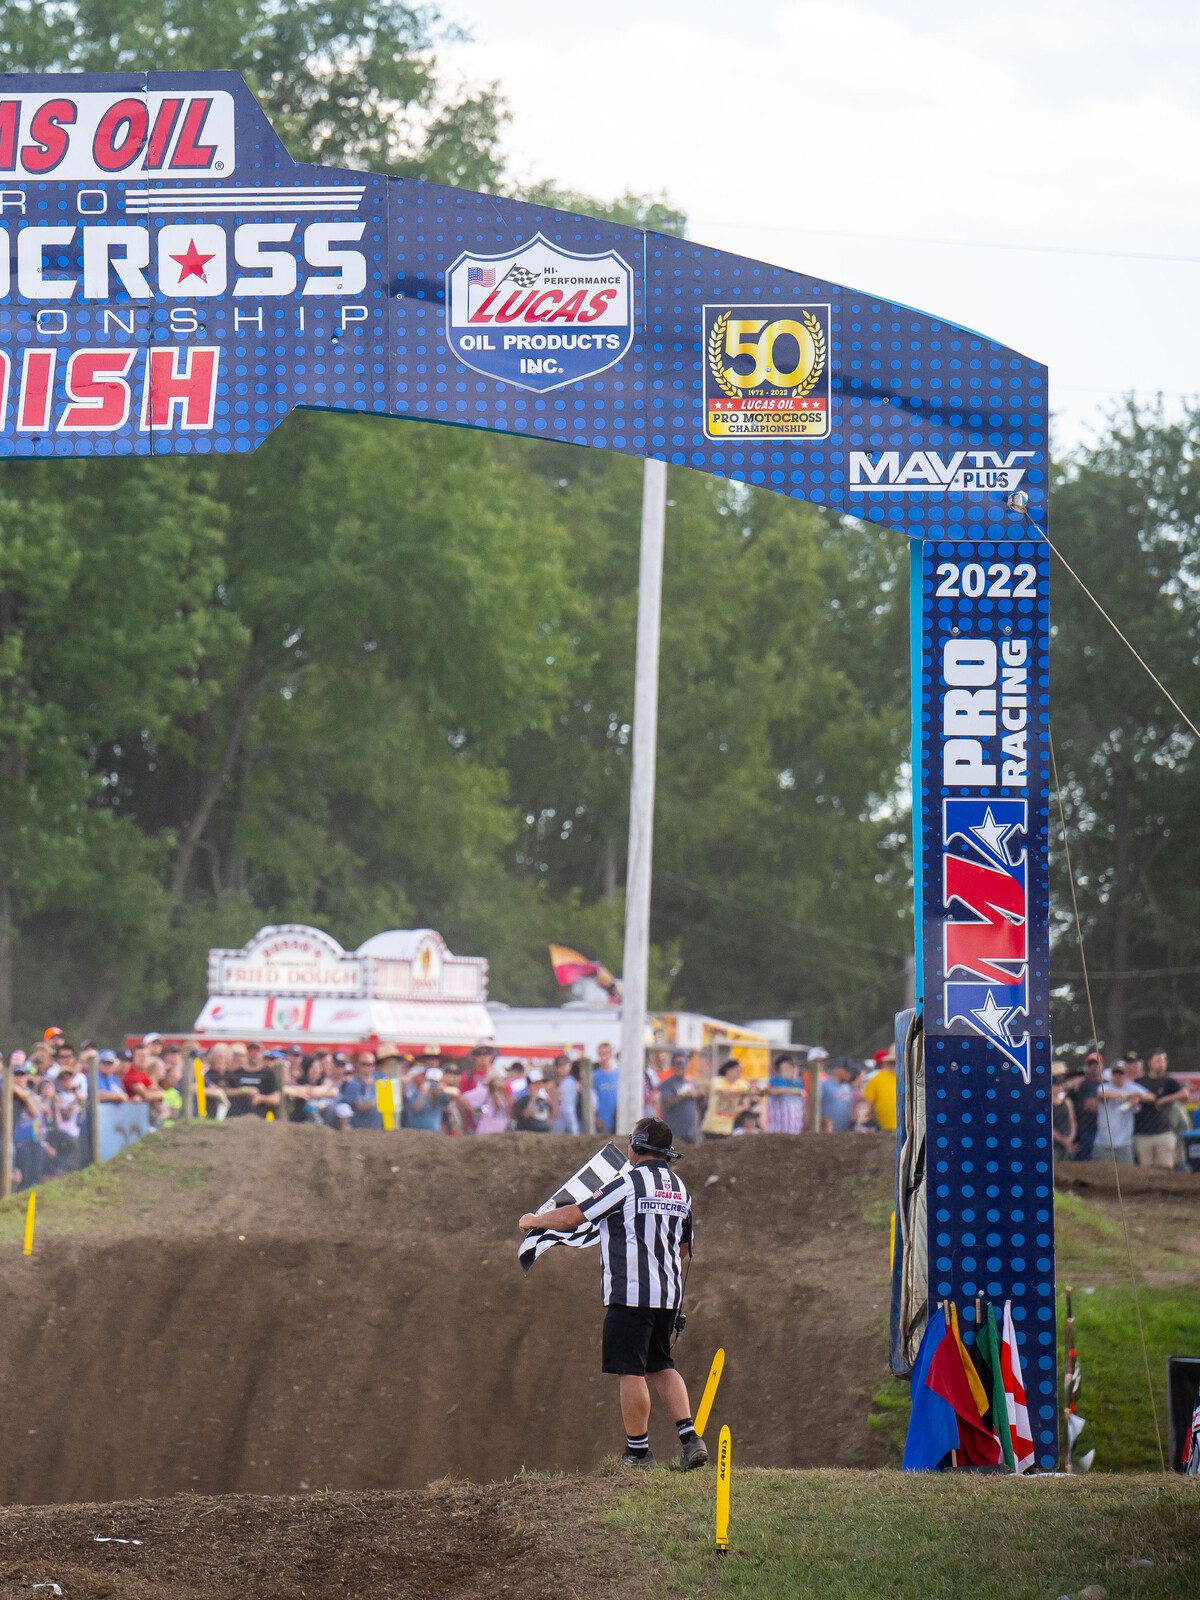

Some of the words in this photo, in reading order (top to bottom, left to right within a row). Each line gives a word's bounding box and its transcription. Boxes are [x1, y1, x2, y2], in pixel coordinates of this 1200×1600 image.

[91, 97, 218, 173] OIL
[544, 277, 621, 285] PERFORMANCE
[468, 289, 617, 323] LUCAS
[459, 335, 496, 351] OIL
[503, 334, 620, 350] PRODUCTS
[723, 319, 816, 389] 50
[713, 414, 740, 423] PRO
[743, 413, 822, 423] MOTOCROSS
[740, 400, 776, 410] LUCAS
[777, 400, 795, 410] OIL
[728, 425, 807, 433] CHAMPIONSHIP
[850, 450, 1037, 484] MAVTV
[963, 472, 1009, 488] PLUS
[935, 563, 1037, 598] 2022
[943, 639, 997, 786] PRO
[1001, 639, 1028, 787] RACING
[654, 1190, 672, 1199] LUCAS
[719, 1439, 728, 1481] ACERBIS
